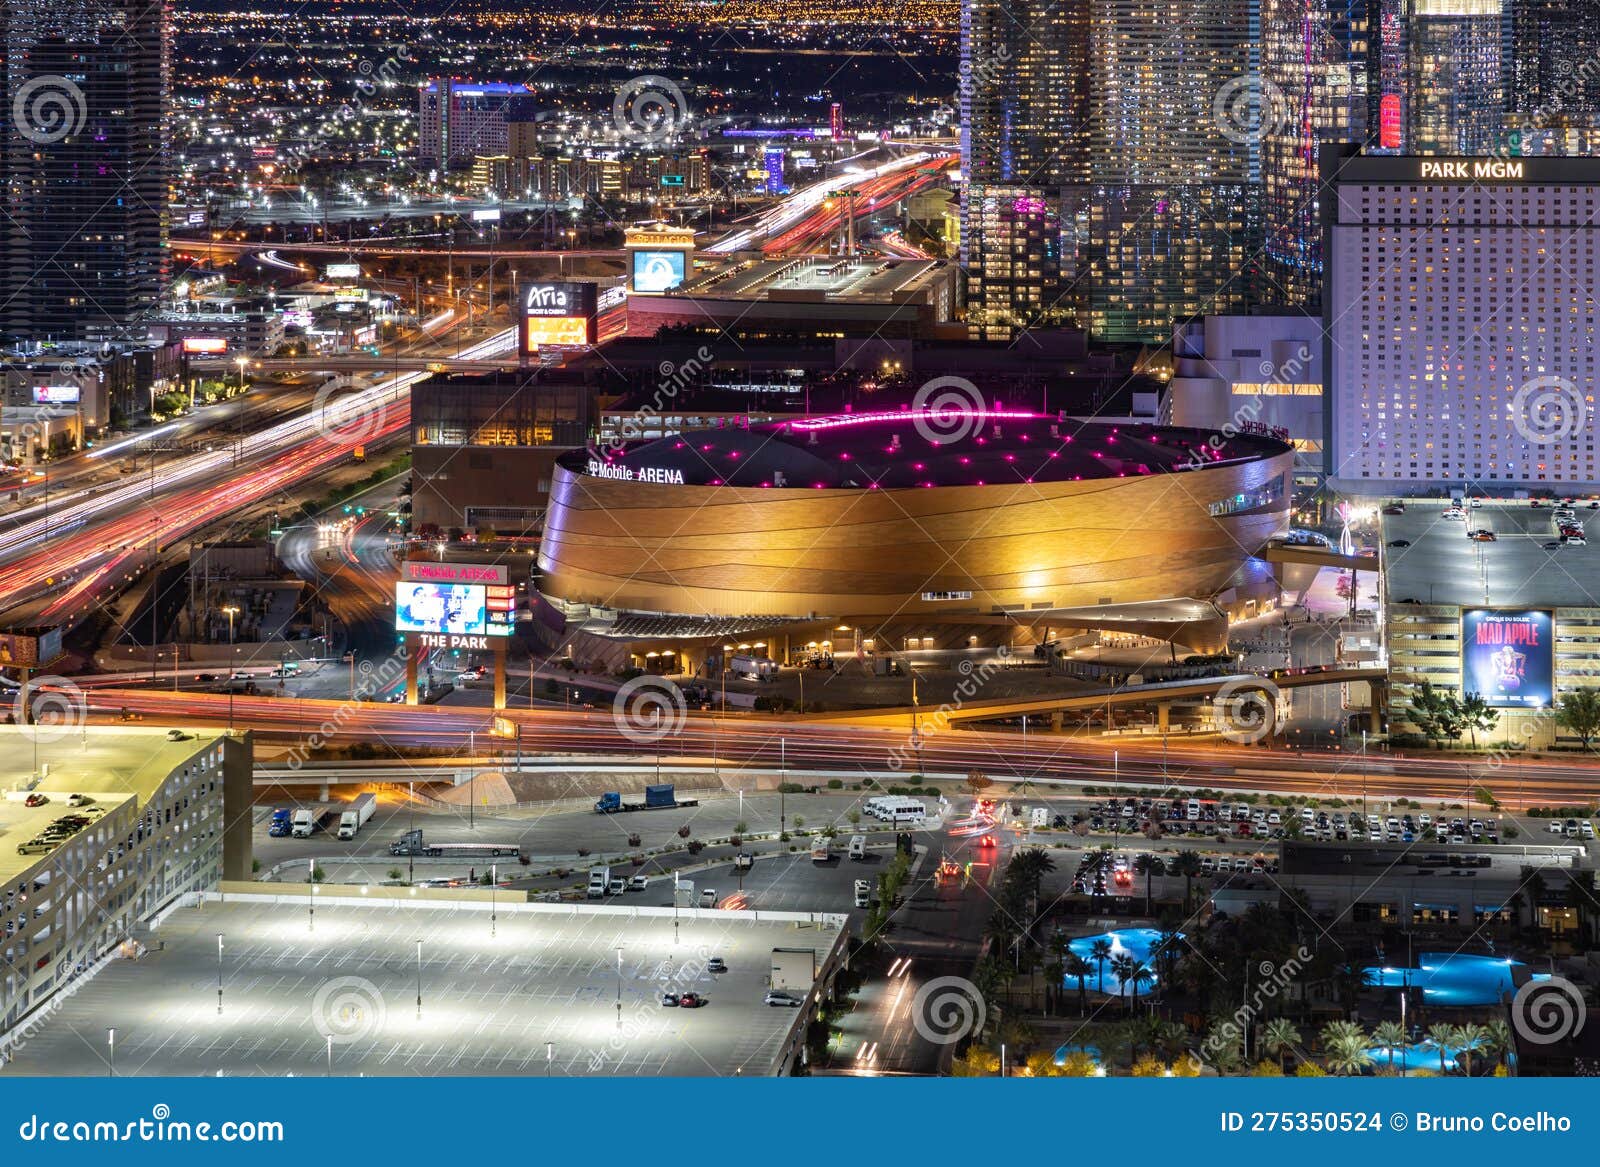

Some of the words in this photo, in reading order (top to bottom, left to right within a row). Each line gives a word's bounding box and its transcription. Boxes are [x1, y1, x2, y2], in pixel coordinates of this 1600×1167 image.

[1421, 162, 1469, 178] PARK
[1474, 162, 1523, 178] MGM
[527, 286, 567, 307] Aria
[639, 467, 684, 485] ARENA
[420, 634, 447, 648] THE
[451, 636, 488, 649] PARK
[1477, 622, 1502, 645] MAD
[1504, 623, 1539, 646] APPLE
